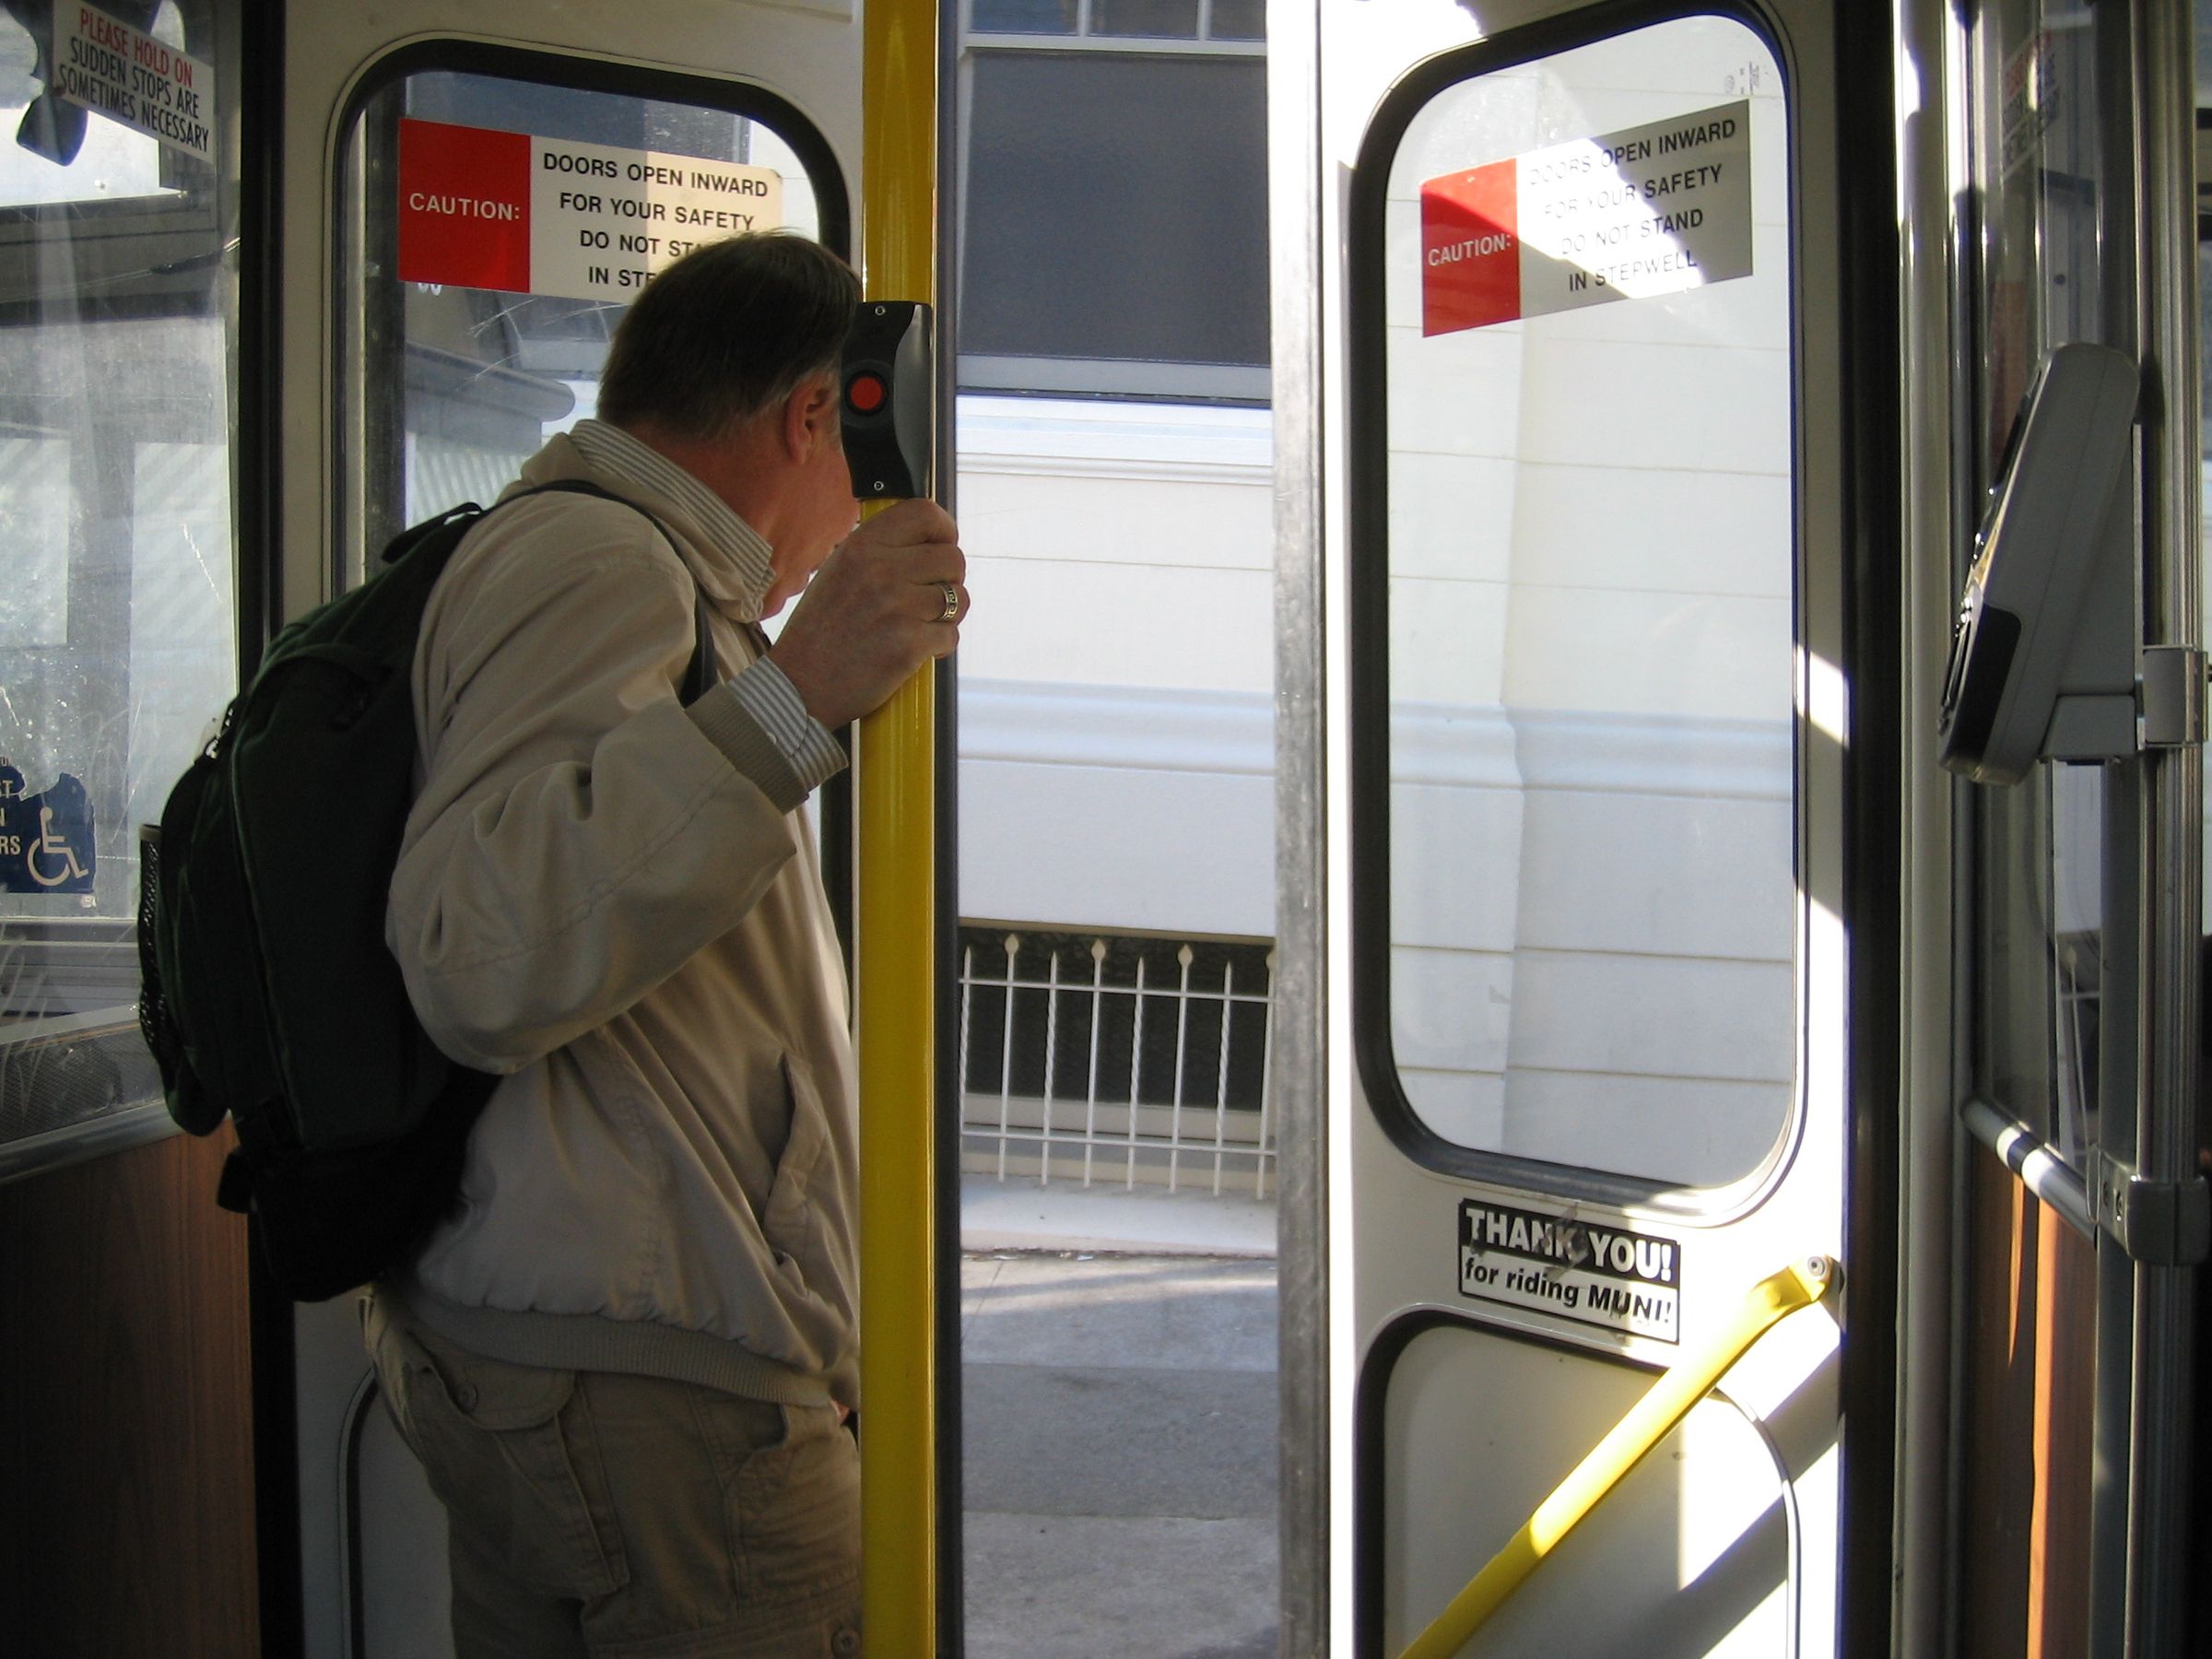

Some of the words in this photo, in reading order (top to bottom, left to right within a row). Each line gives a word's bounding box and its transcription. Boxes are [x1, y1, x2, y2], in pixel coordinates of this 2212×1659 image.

[80, 8, 128, 57] PLEASE
[134, 37, 170, 75] HOLD
[175, 57, 192, 88] ON
[71, 37, 126, 83] SUDDEN
[132, 67, 171, 105] STOPS
[176, 89, 199, 119] ARE
[59, 64, 135, 121] SOMETIMES
[141, 100, 208, 153] NECESSARY
[544, 152, 618, 179] DOORS
[628, 163, 682, 187] OPEN
[691, 172, 768, 197] INWARD
[1530, 155, 1592, 185] DOORS
[1601, 140, 1651, 167] OPEN
[1659, 119, 1735, 154] INWARD
[409, 192, 520, 221] CAUTION:
[560, 193, 601, 213] FOR
[610, 198, 665, 221] YOUR
[675, 206, 754, 230] SAFETY
[1545, 199, 1578, 218] FOR
[1586, 184, 1636, 208] YOUR
[1644, 163, 1722, 200] SAFETY
[581, 230, 608, 249] DO
[619, 234, 660, 255] NOT
[668, 241, 703, 259] ST
[1428, 234, 1512, 267] CAUTION:
[1562, 234, 1585, 254] DO
[1596, 225, 1630, 246] NOT
[1641, 208, 1703, 238] STAND
[588, 265, 608, 285] IN
[1570, 271, 1586, 291] IN
[1595, 250, 1698, 287] STEPWELL
[1465, 1207, 1579, 1262] THANK
[1588, 1231, 1672, 1282] YOU!
[1465, 1257, 1499, 1285] for
[1506, 1269, 1579, 1309] riding
[1588, 1285, 1671, 1324] MUNI!
